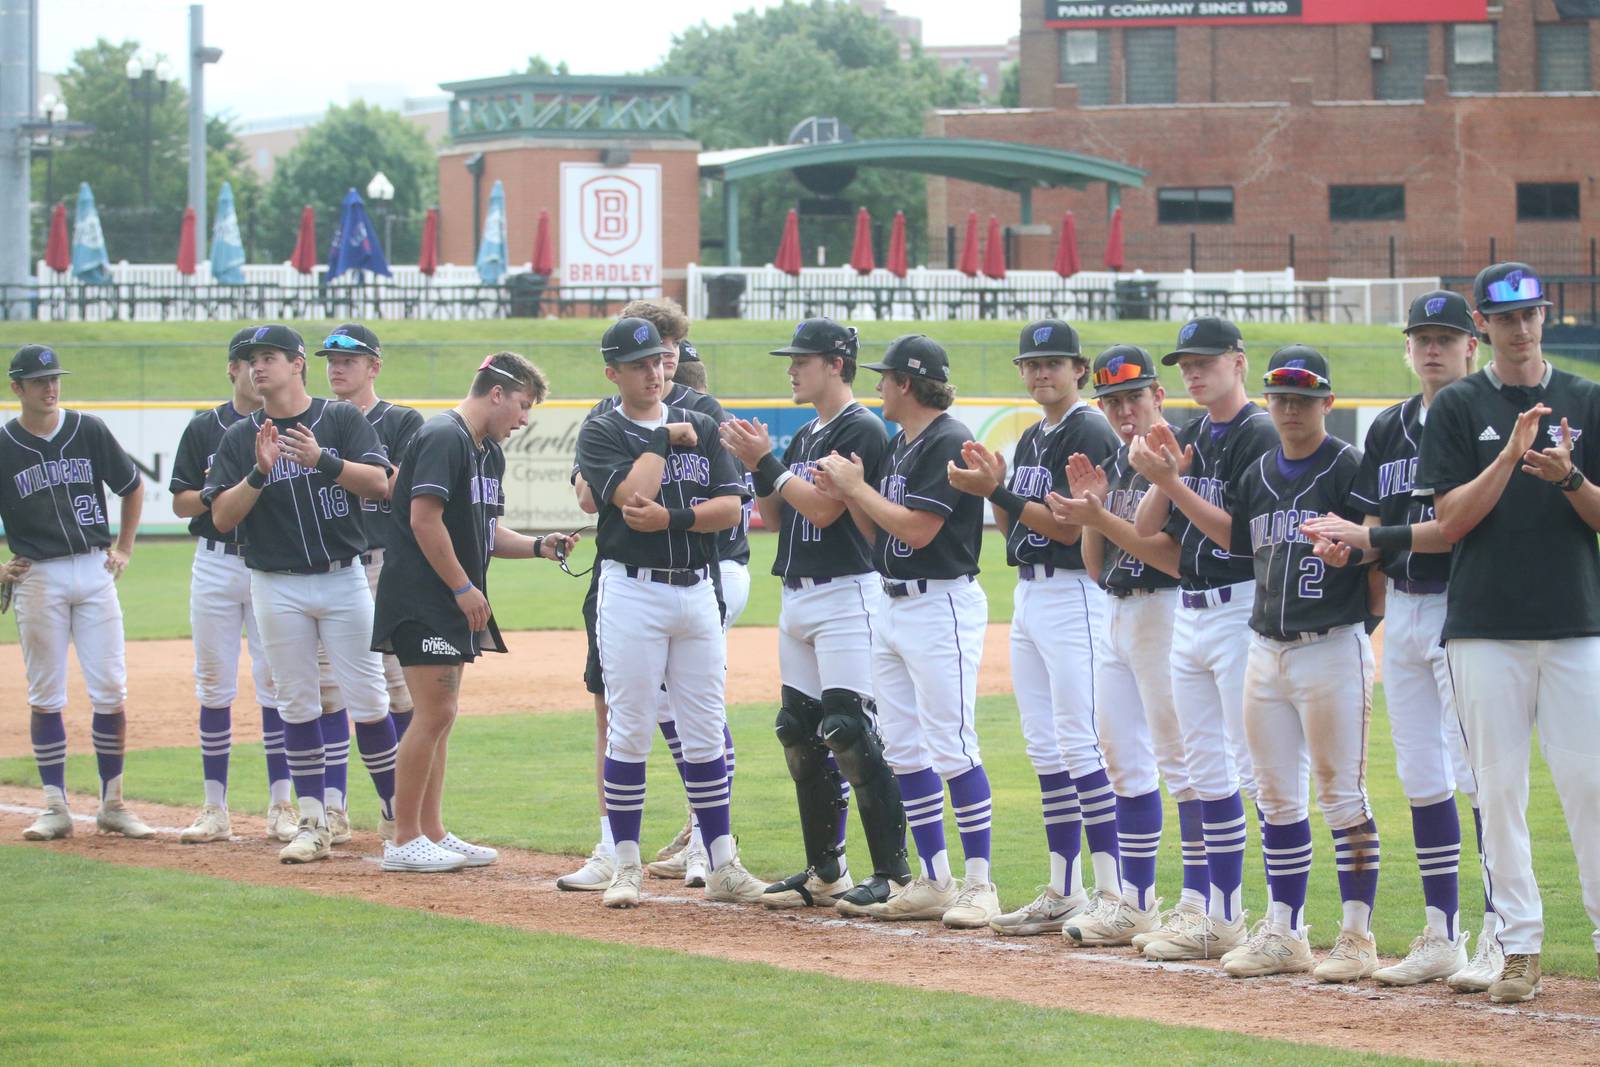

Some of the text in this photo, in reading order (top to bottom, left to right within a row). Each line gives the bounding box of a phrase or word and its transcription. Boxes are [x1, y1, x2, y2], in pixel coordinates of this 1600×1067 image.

[1057, 1, 1287, 17] PAINT COMPANY SINCE 1920
[594, 189, 628, 240] B
[569, 264, 653, 282] BRADLEY
[318, 484, 350, 520] 18
[1297, 555, 1326, 599] 2
